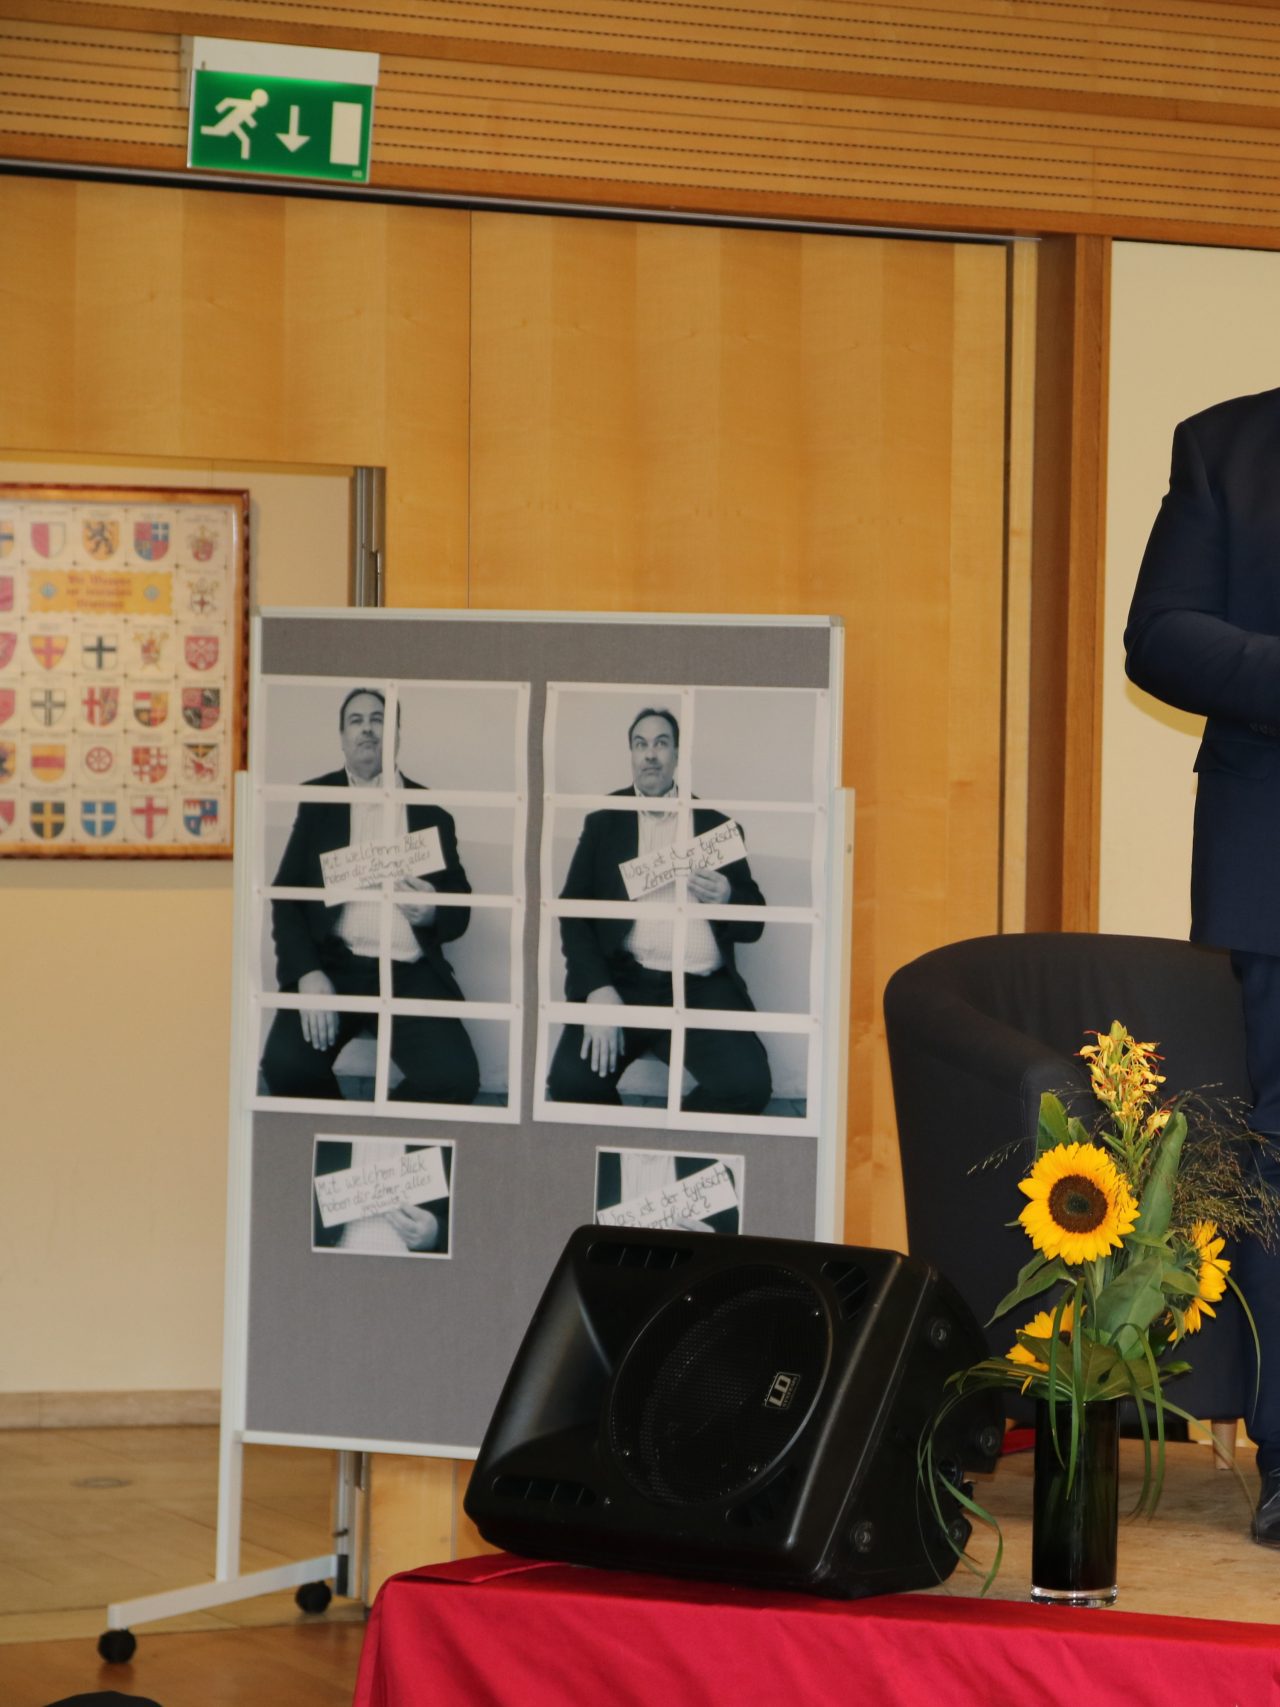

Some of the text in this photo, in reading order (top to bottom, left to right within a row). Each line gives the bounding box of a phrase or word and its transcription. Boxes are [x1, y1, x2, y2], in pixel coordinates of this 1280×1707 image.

[400, 1155, 426, 1177] Blick
[640, 1197, 656, 1216] ist
[660, 1190, 679, 1208] der
